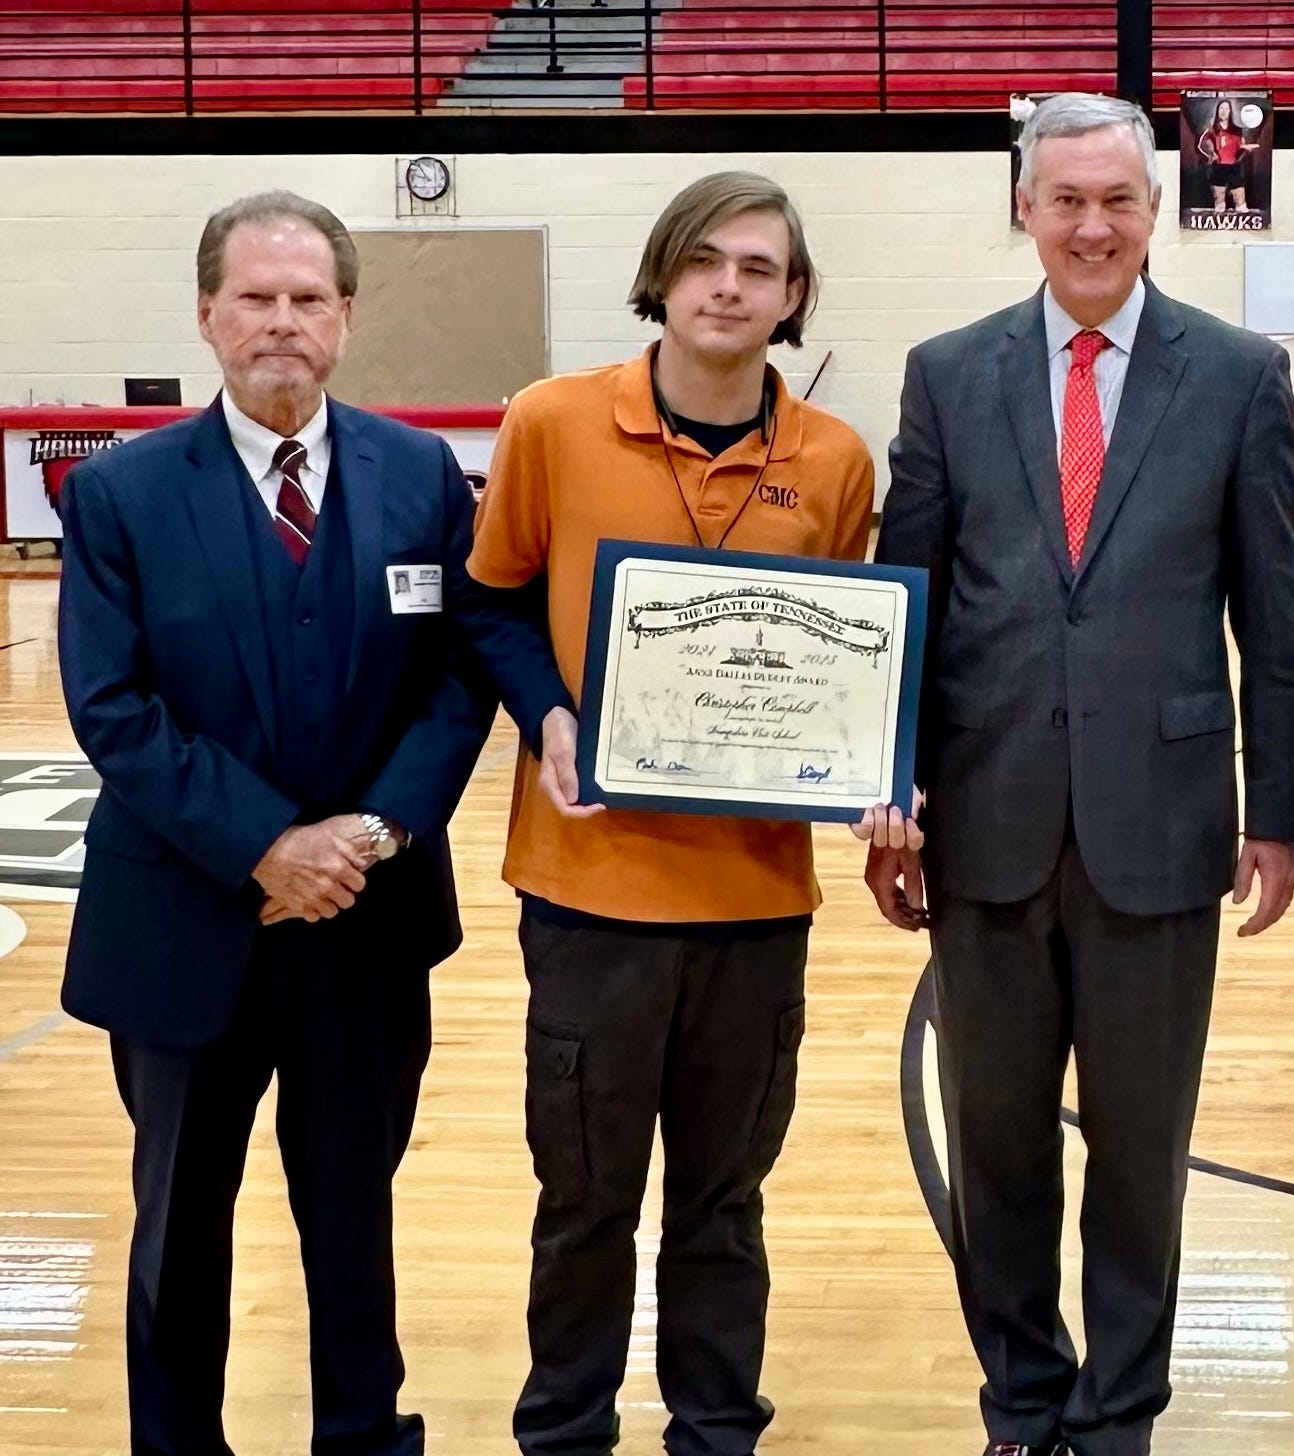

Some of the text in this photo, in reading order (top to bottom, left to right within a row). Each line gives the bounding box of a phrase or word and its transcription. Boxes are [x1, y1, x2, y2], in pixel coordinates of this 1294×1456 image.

[1190, 215, 1263, 230] HAWKS
[674, 608, 702, 622] THE
[750, 600, 769, 611] OF
[772, 602, 847, 636] TENNESSEE
